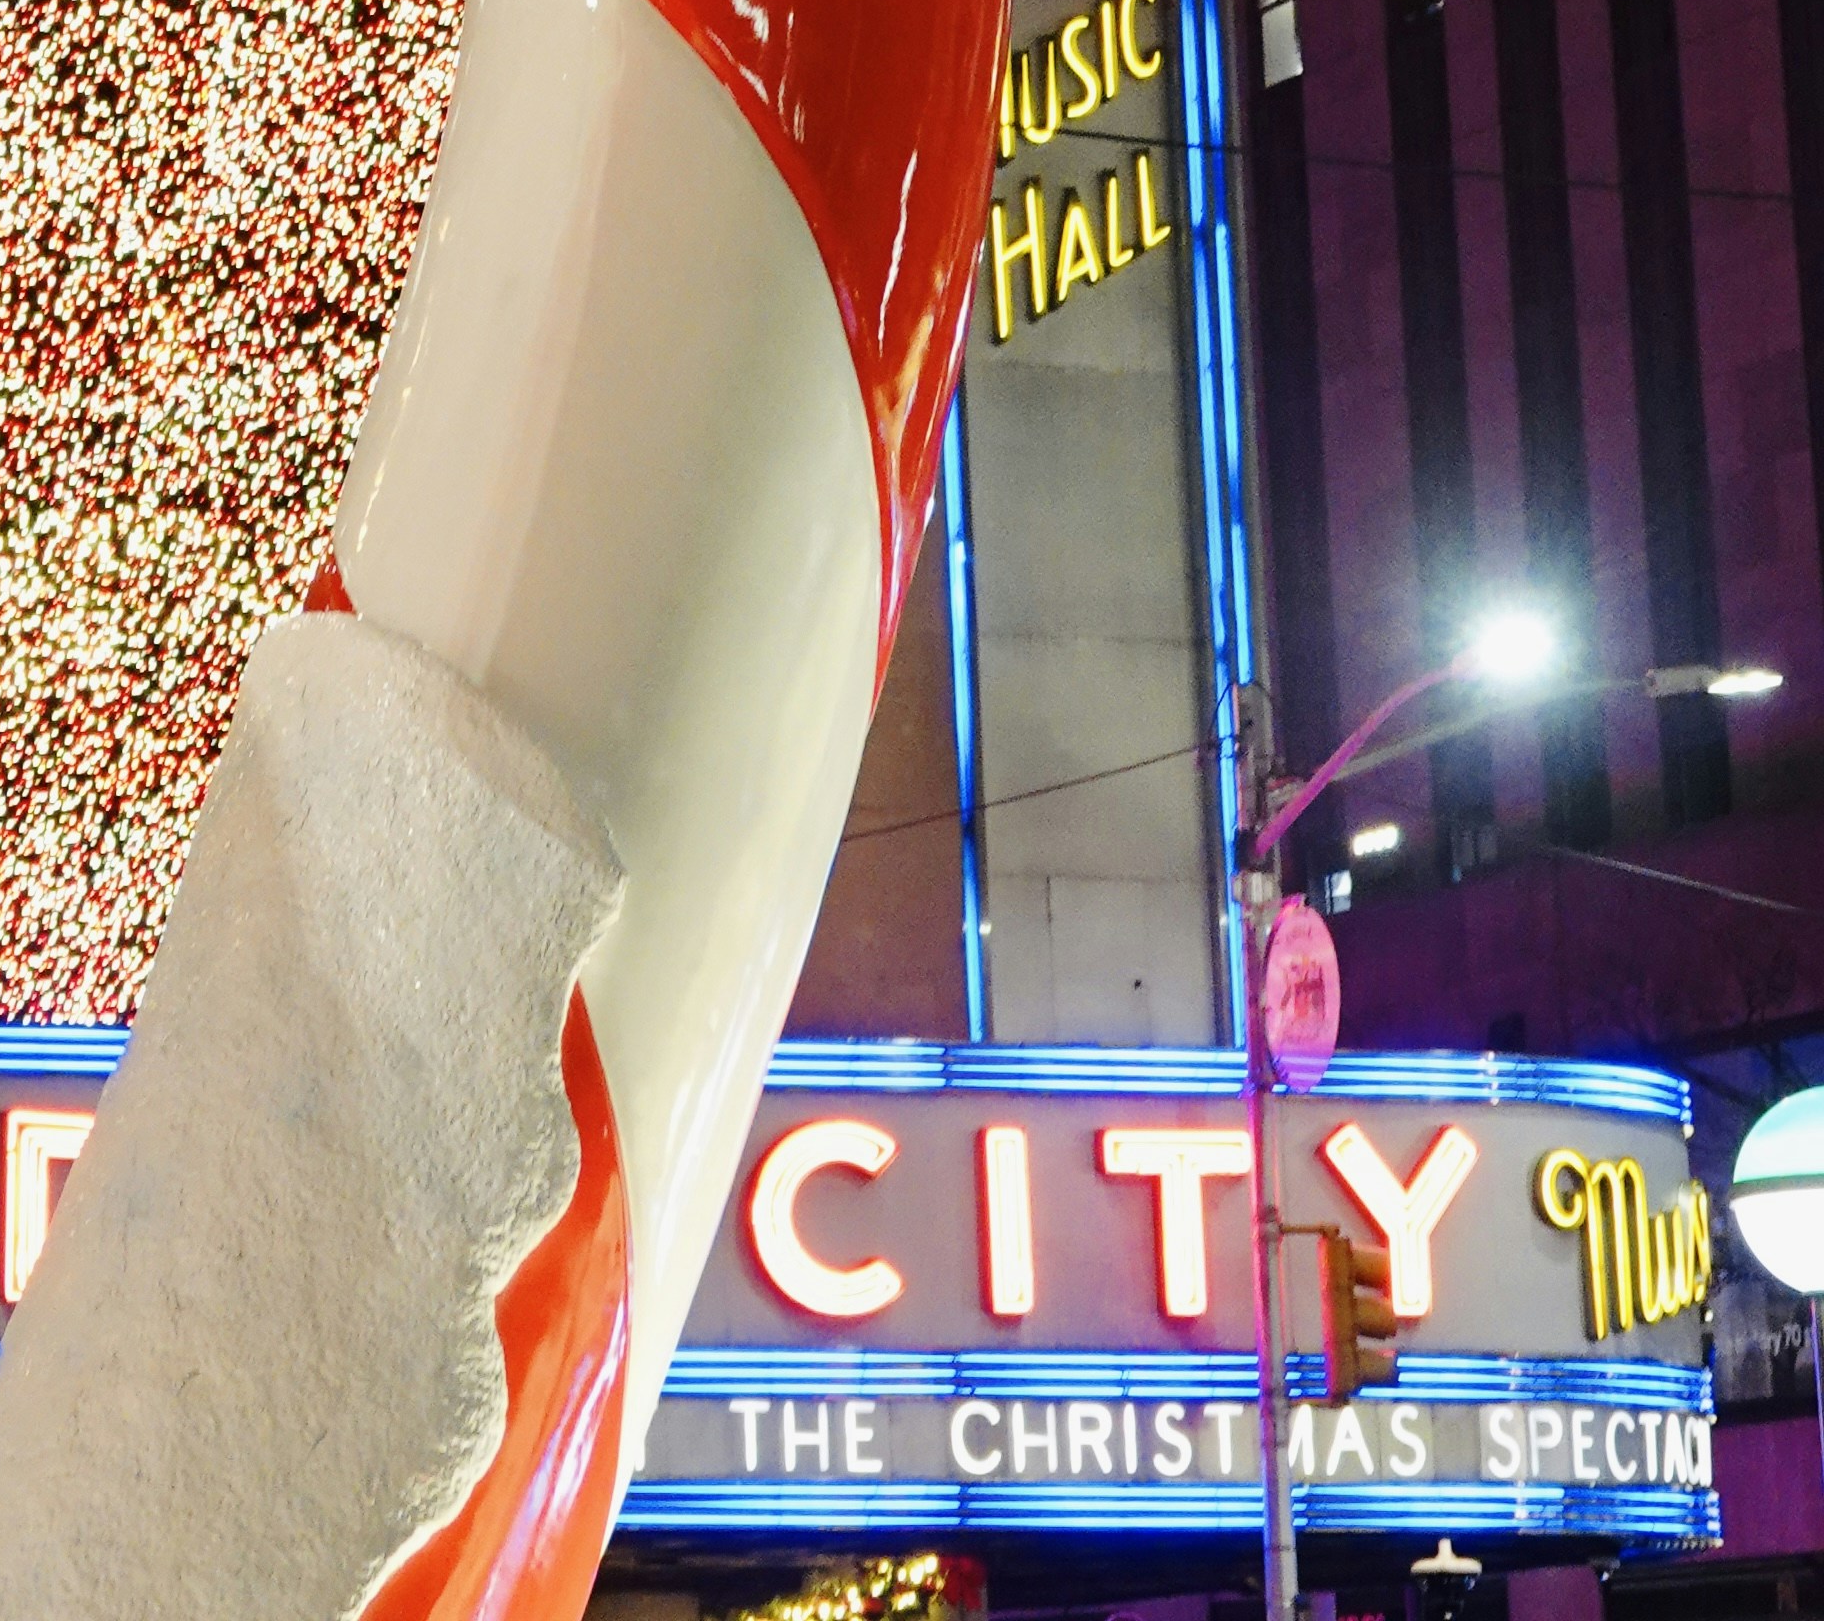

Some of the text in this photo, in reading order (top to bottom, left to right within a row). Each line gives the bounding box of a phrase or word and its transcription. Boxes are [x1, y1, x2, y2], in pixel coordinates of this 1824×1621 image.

[989, 153, 1171, 340] HALL
[750, 1119, 1478, 1321] CITY
[728, 1399, 883, 1474] THE
